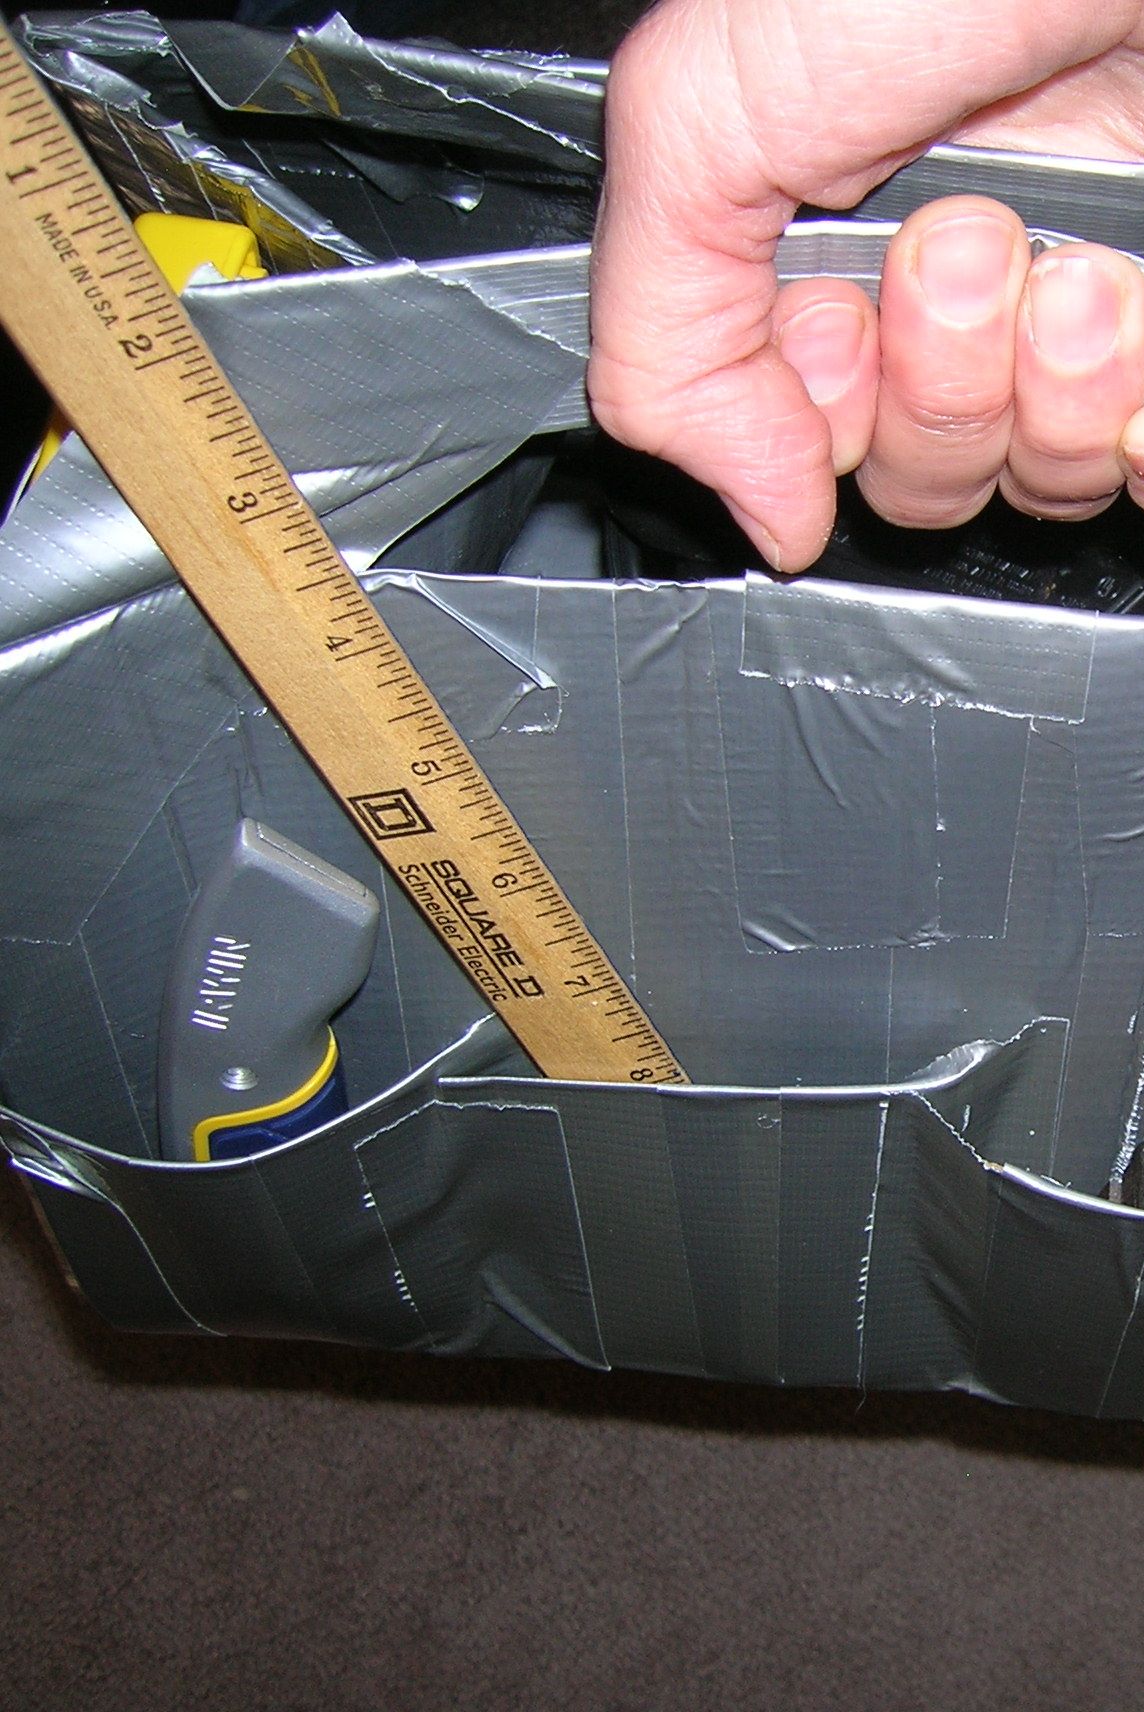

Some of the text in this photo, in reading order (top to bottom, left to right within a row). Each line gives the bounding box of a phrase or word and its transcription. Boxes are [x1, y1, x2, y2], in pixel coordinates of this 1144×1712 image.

[5, 165, 39, 184] 1
[35, 212, 80, 262] MADE
[69, 265, 93, 284] IN
[118, 333, 153, 359] 2
[227, 491, 258, 514] 3
[324, 635, 354, 654] 4
[411, 760, 443, 777] 5
[491, 872, 518, 889] 6
[398, 863, 508, 1002] Schneider Electric
[430, 859, 546, 998] SQUARE D
[191, 935, 251, 1030] IRWIN
[563, 975, 591, 988] 7
[629, 1067, 654, 1082] 8
